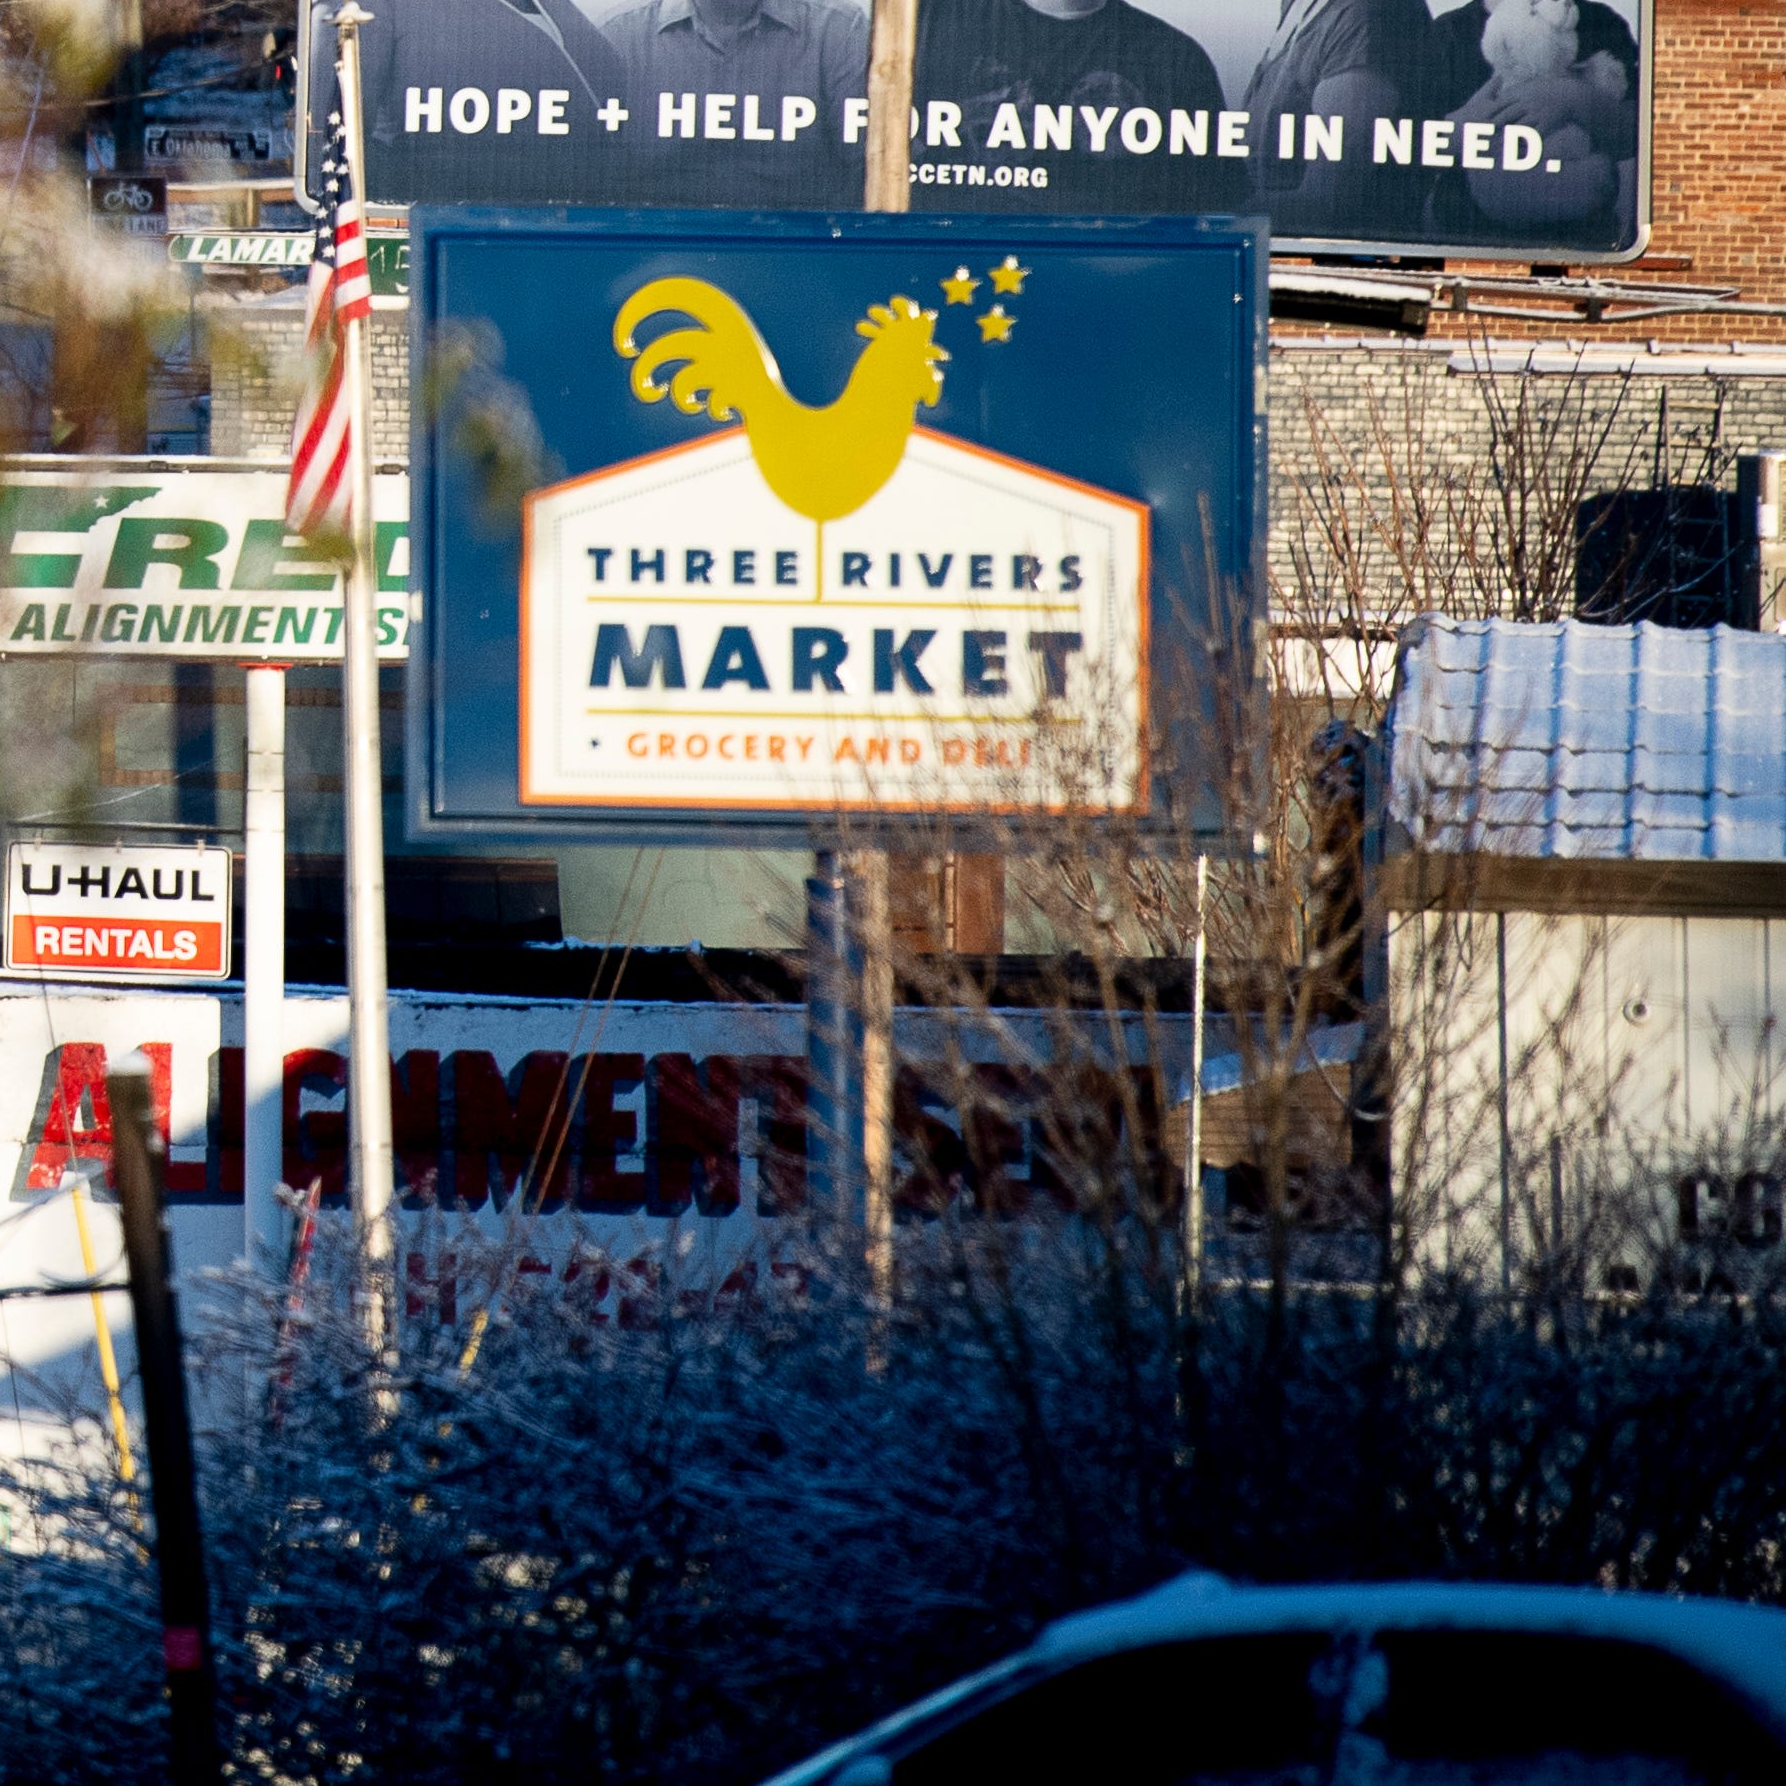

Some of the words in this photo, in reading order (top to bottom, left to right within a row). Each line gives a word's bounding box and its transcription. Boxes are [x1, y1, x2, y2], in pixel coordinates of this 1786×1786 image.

[405, 86, 570, 135] HOPE
[657, 91, 817, 142] HELP
[843, 97, 962, 148] FR
[986, 102, 1250, 158] ANYONE
[1278, 112, 1344, 163] IN
[1372, 117, 1563, 174] NEED.
[187, 236, 316, 264] LAMAR
[585, 546, 801, 586] THREE
[841, 551, 1086, 592] RIVERS
[10, 602, 346, 645] ALIGNMENT
[587, 622, 1084, 700] MARKET
[626, 732, 816, 763] GROCERY
[834, 736, 920, 764] AND
[21, 862, 216, 904] U-HAUL
[32, 924, 199, 962] RENTALS
